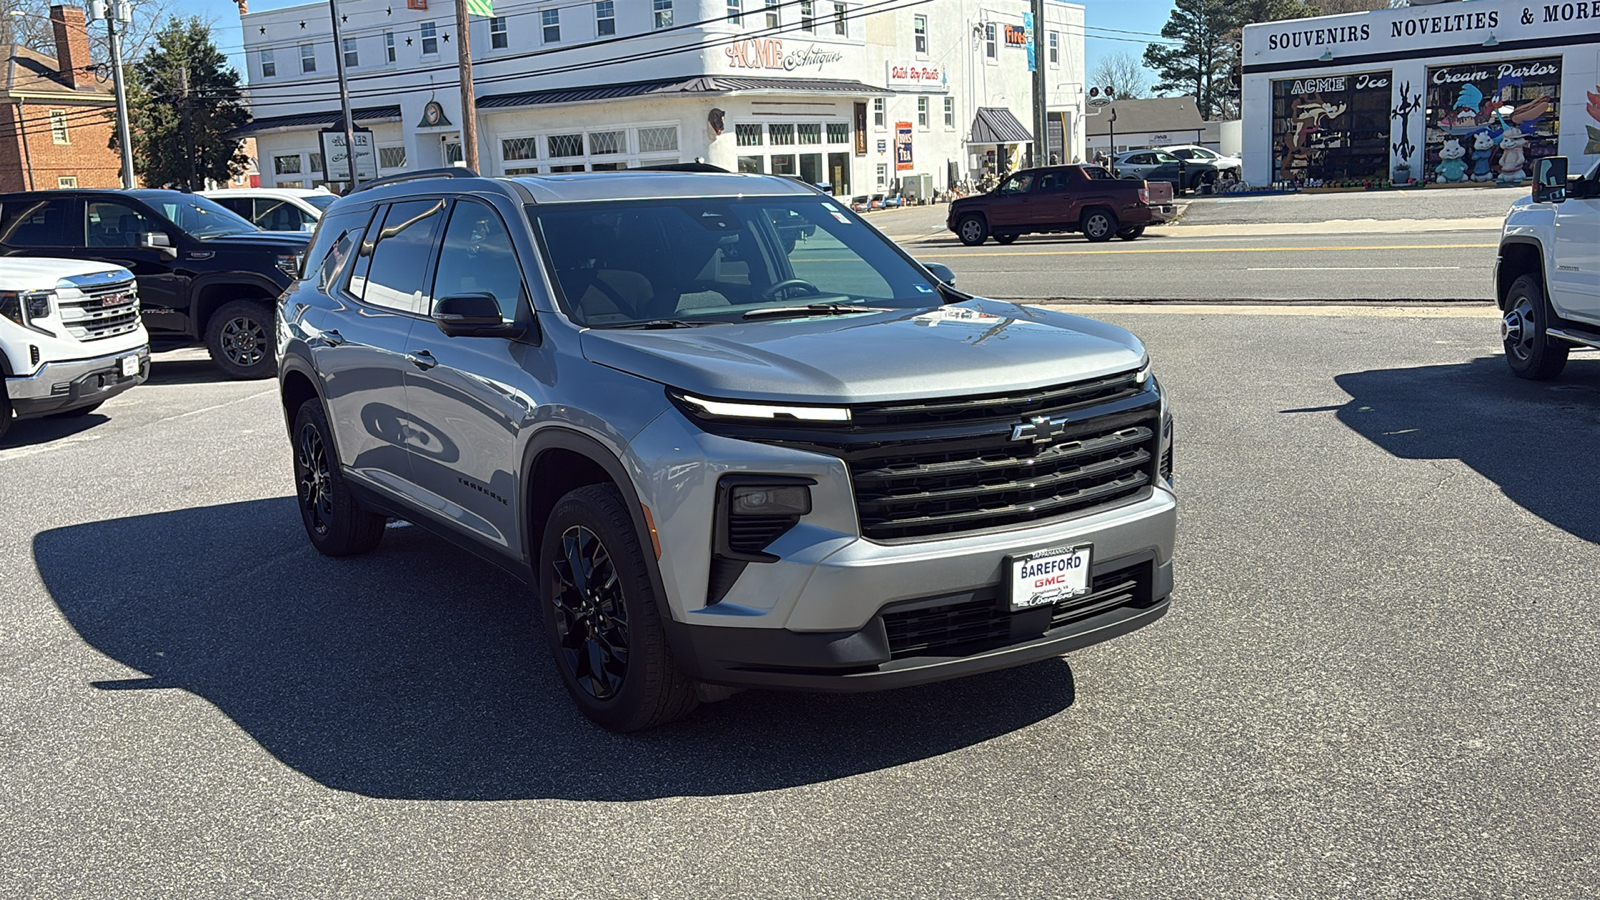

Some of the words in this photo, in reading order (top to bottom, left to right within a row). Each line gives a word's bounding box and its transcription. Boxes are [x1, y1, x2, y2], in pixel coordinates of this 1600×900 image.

[1004, 25, 1026, 44] Fires
[1268, 24, 1370, 50] SOUVENIRS
[1391, 11, 1499, 37] NOVELTIES
[1520, 7, 1534, 25] &
[1543, 0, 1600, 22] MORE
[725, 38, 783, 70] ACME
[783, 43, 842, 72] Antiques
[892, 66, 908, 79] Dutch
[910, 67, 921, 83] Boy
[921, 67, 939, 80] Paints
[1433, 68, 1489, 84] Cream
[1497, 62, 1558, 79] Parlor
[1291, 77, 1345, 94] ACME
[1355, 74, 1389, 90] Ice
[899, 148, 911, 161] TEA
[457, 476, 508, 506] TRAVERSE
[1021, 556, 1082, 579] BAREFORD
[1034, 574, 1066, 588] GMC
